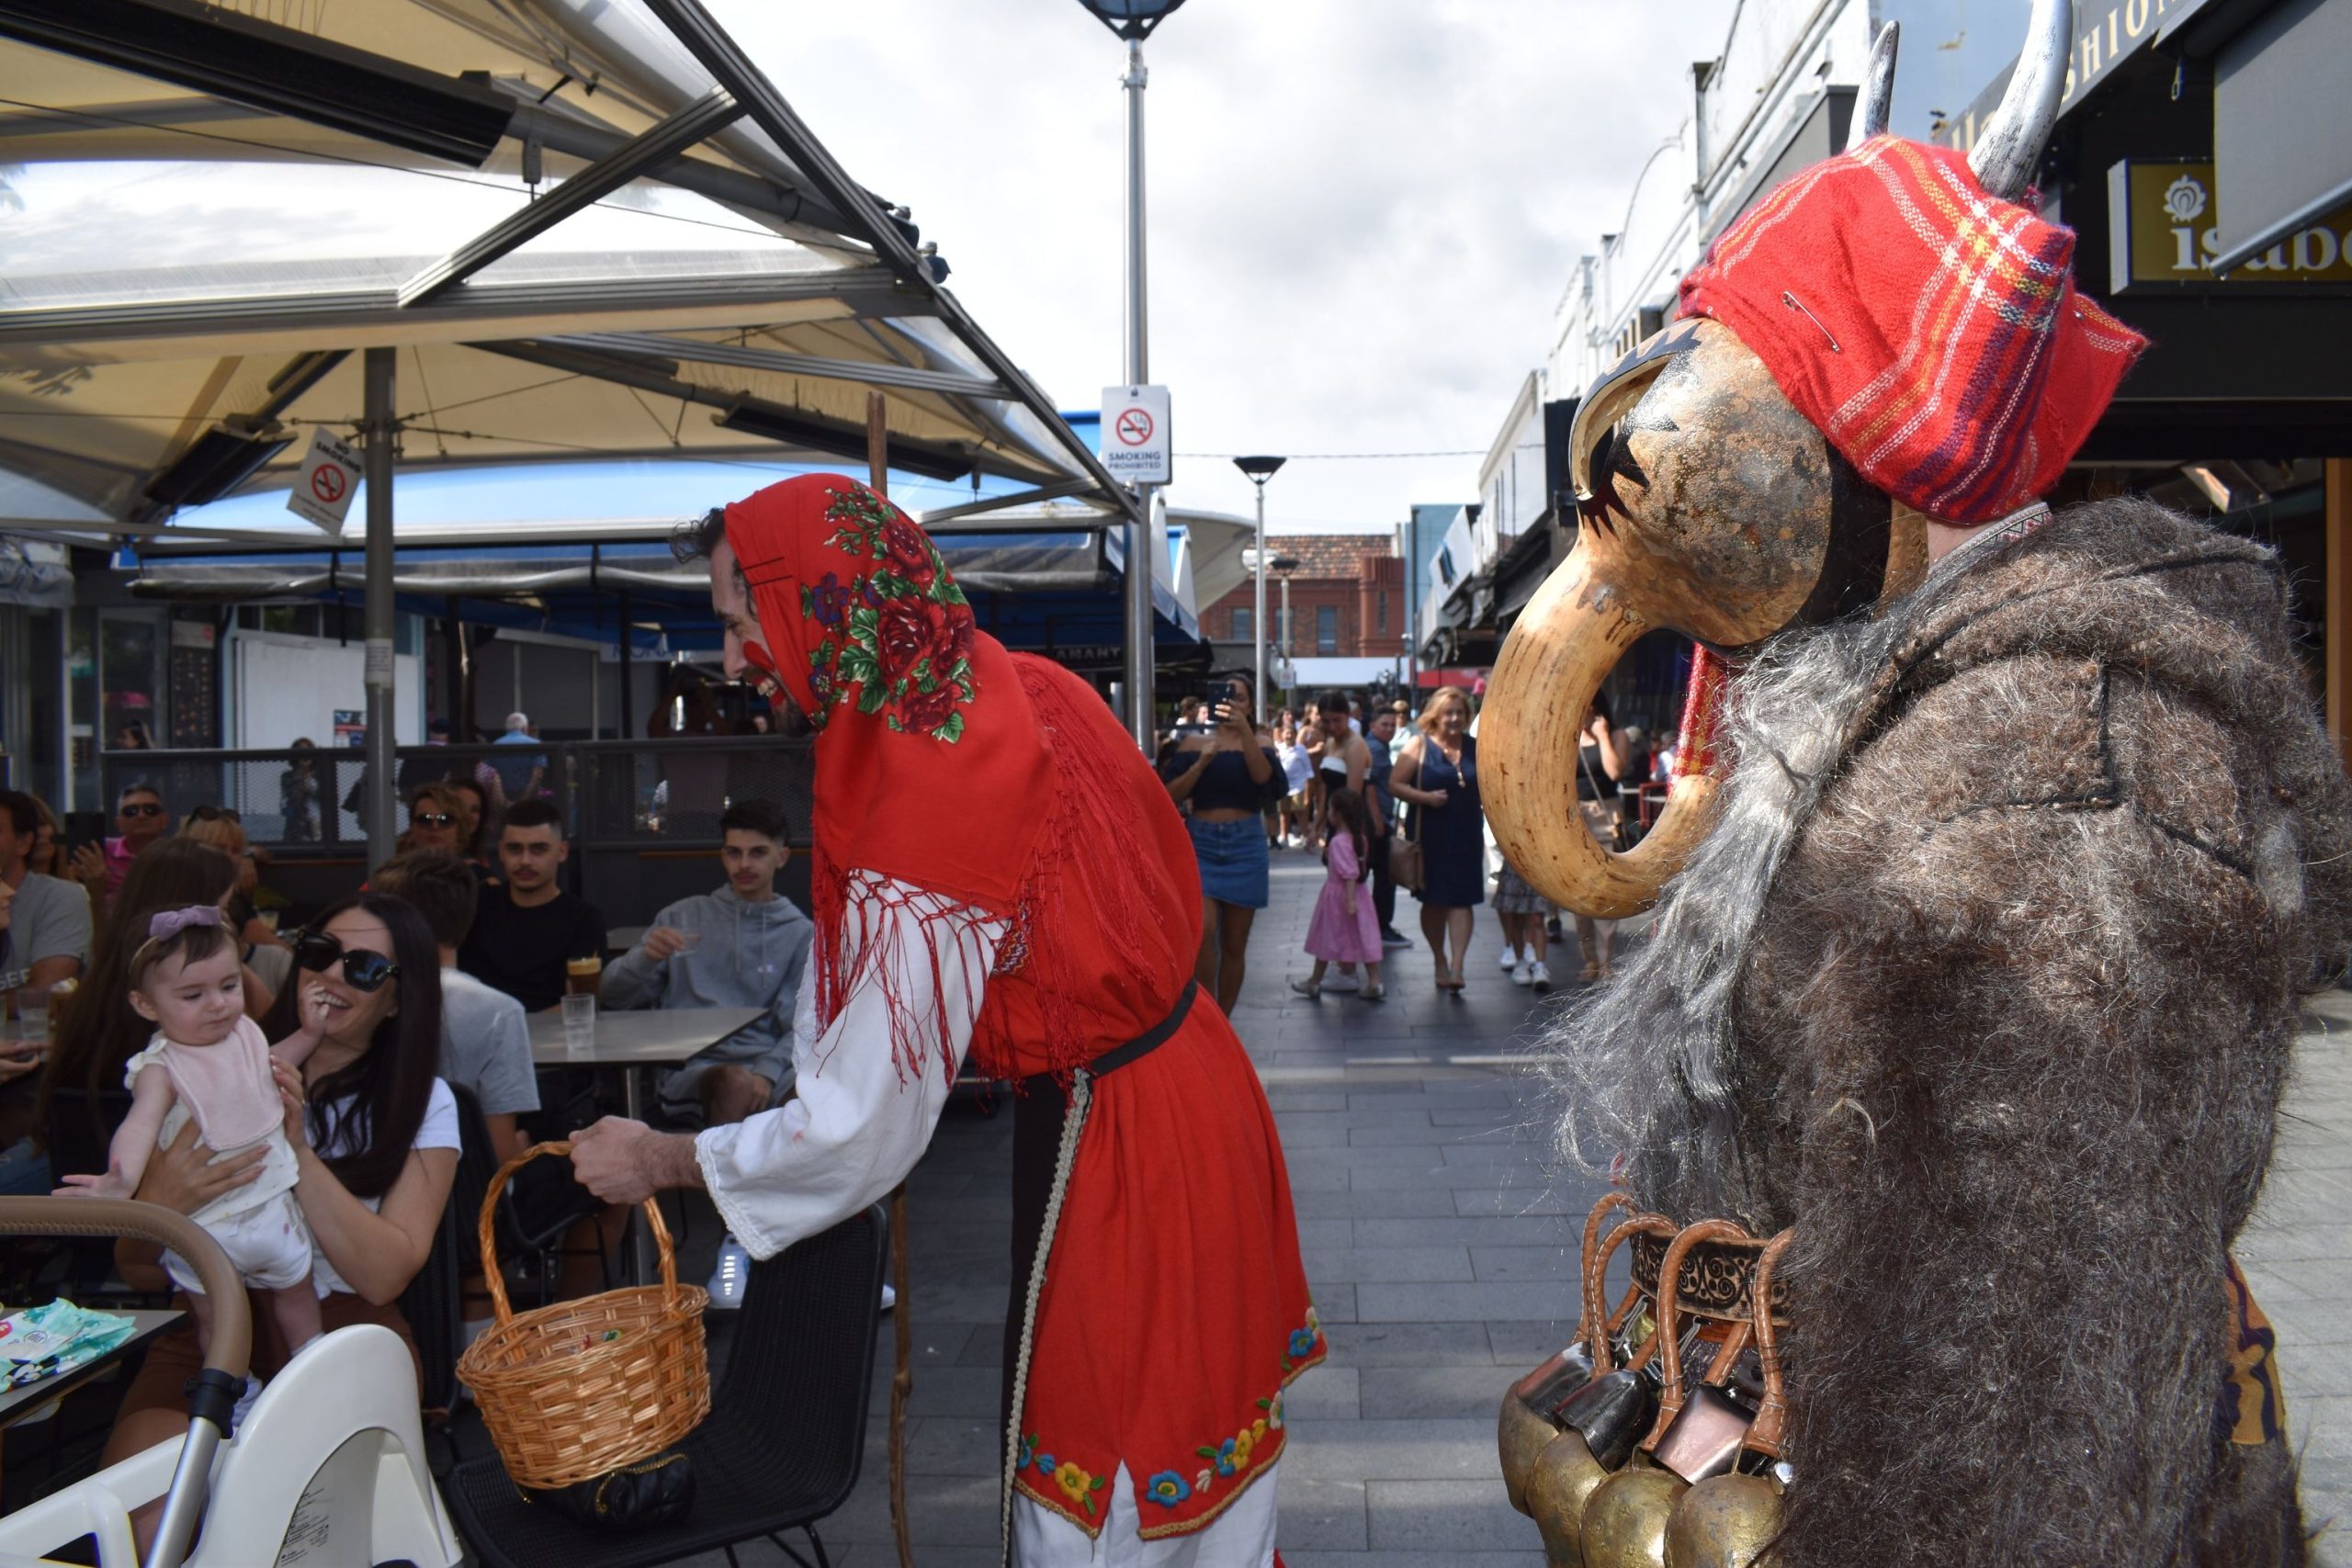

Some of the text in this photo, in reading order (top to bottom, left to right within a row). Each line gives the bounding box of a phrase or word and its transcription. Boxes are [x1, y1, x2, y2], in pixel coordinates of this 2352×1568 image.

[334, 442, 349, 456] NO
[316, 441, 361, 473] SMOKING
[1108, 451, 1160, 461] SMOKING
[1108, 461, 1161, 469] PROHIBITED
